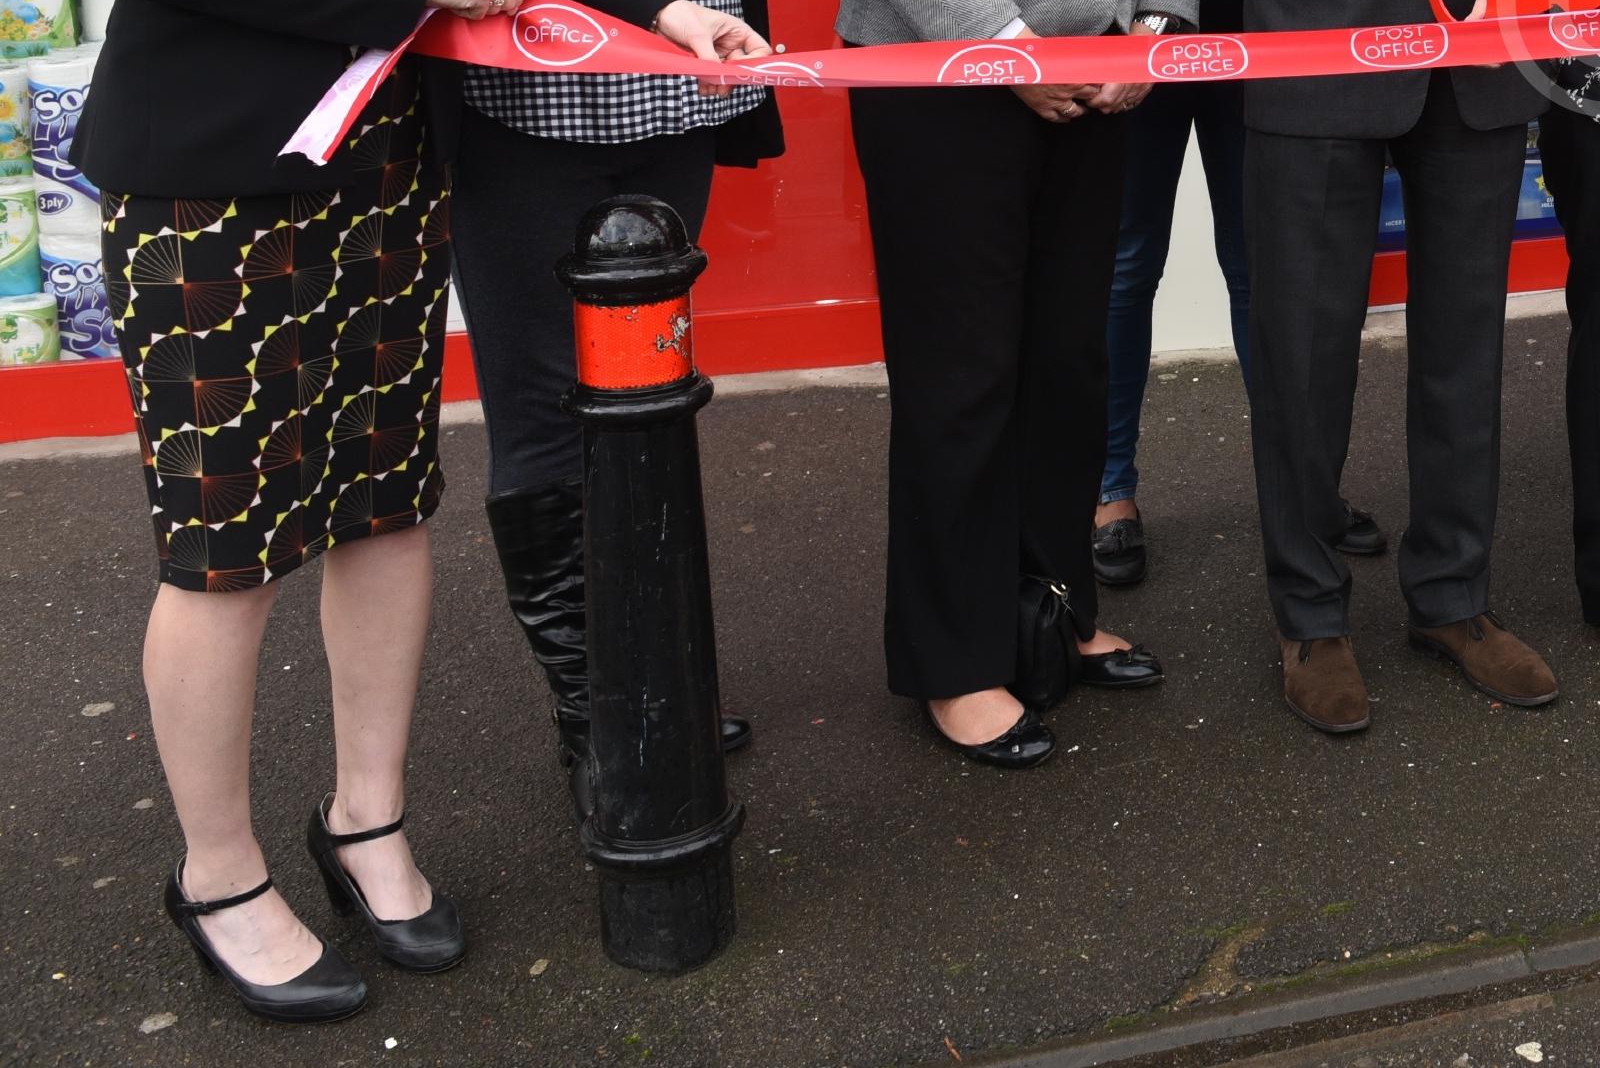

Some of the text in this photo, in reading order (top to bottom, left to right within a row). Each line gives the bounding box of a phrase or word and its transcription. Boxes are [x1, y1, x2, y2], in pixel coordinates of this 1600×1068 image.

[1375, 26, 1426, 41] POST
[1172, 42, 1224, 60] POST
[1364, 40, 1435, 60] OFFICE
[963, 59, 1017, 77] POST
[1161, 59, 1235, 75] OFFICE
